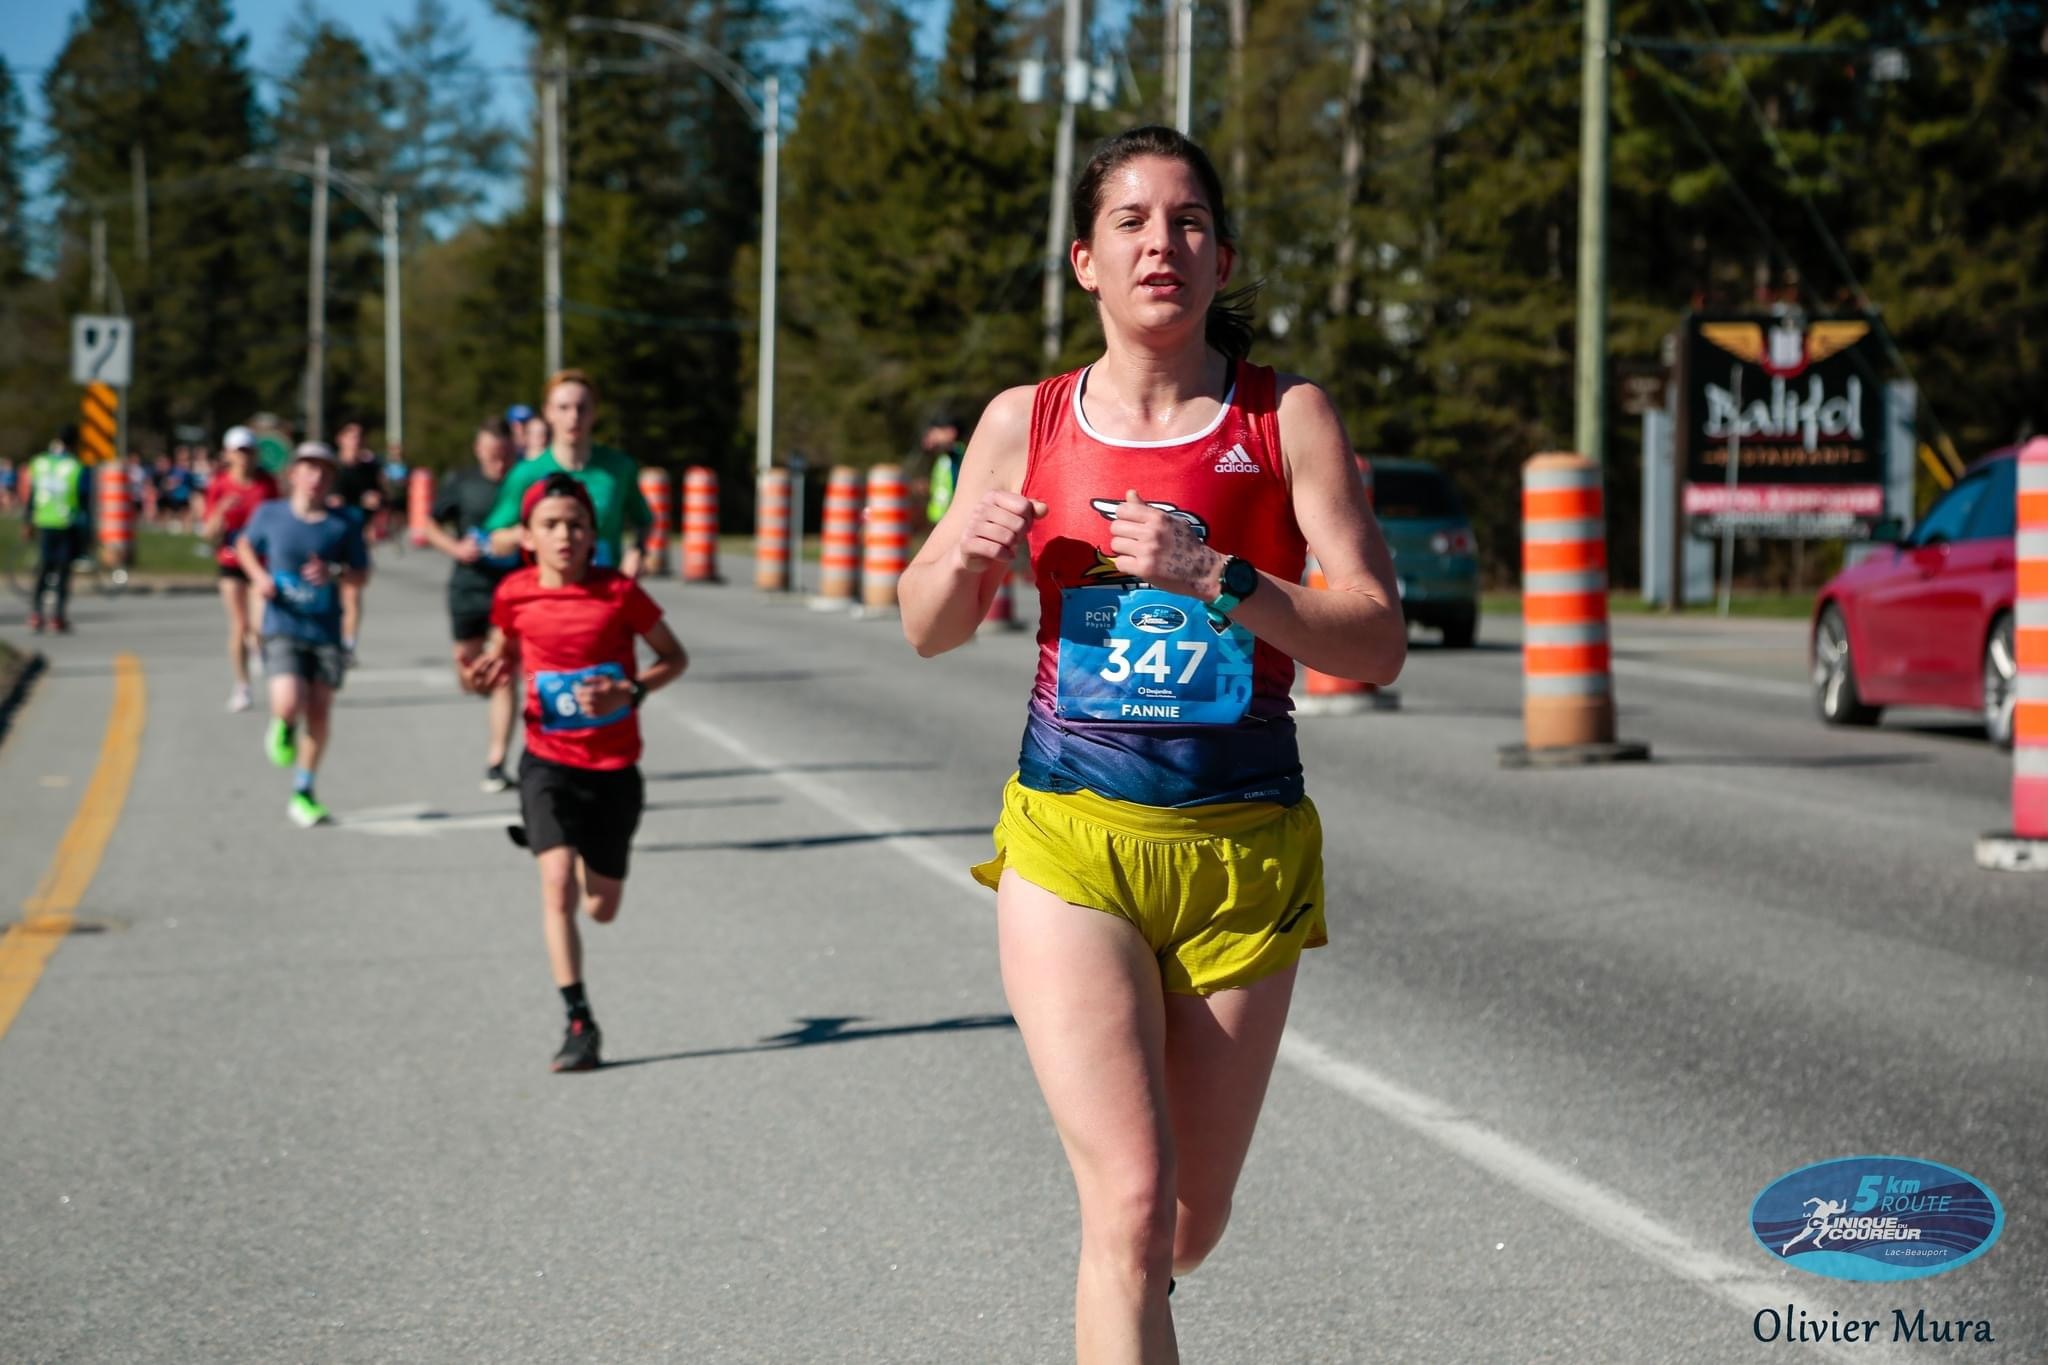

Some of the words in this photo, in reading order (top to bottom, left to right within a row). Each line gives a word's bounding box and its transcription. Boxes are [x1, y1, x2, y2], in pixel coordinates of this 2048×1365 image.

[1214, 462, 1260, 473] adidas
[1085, 611, 1111, 622] PCN
[1099, 638, 1208, 685] 347
[1121, 704, 1180, 718] FANNIE
